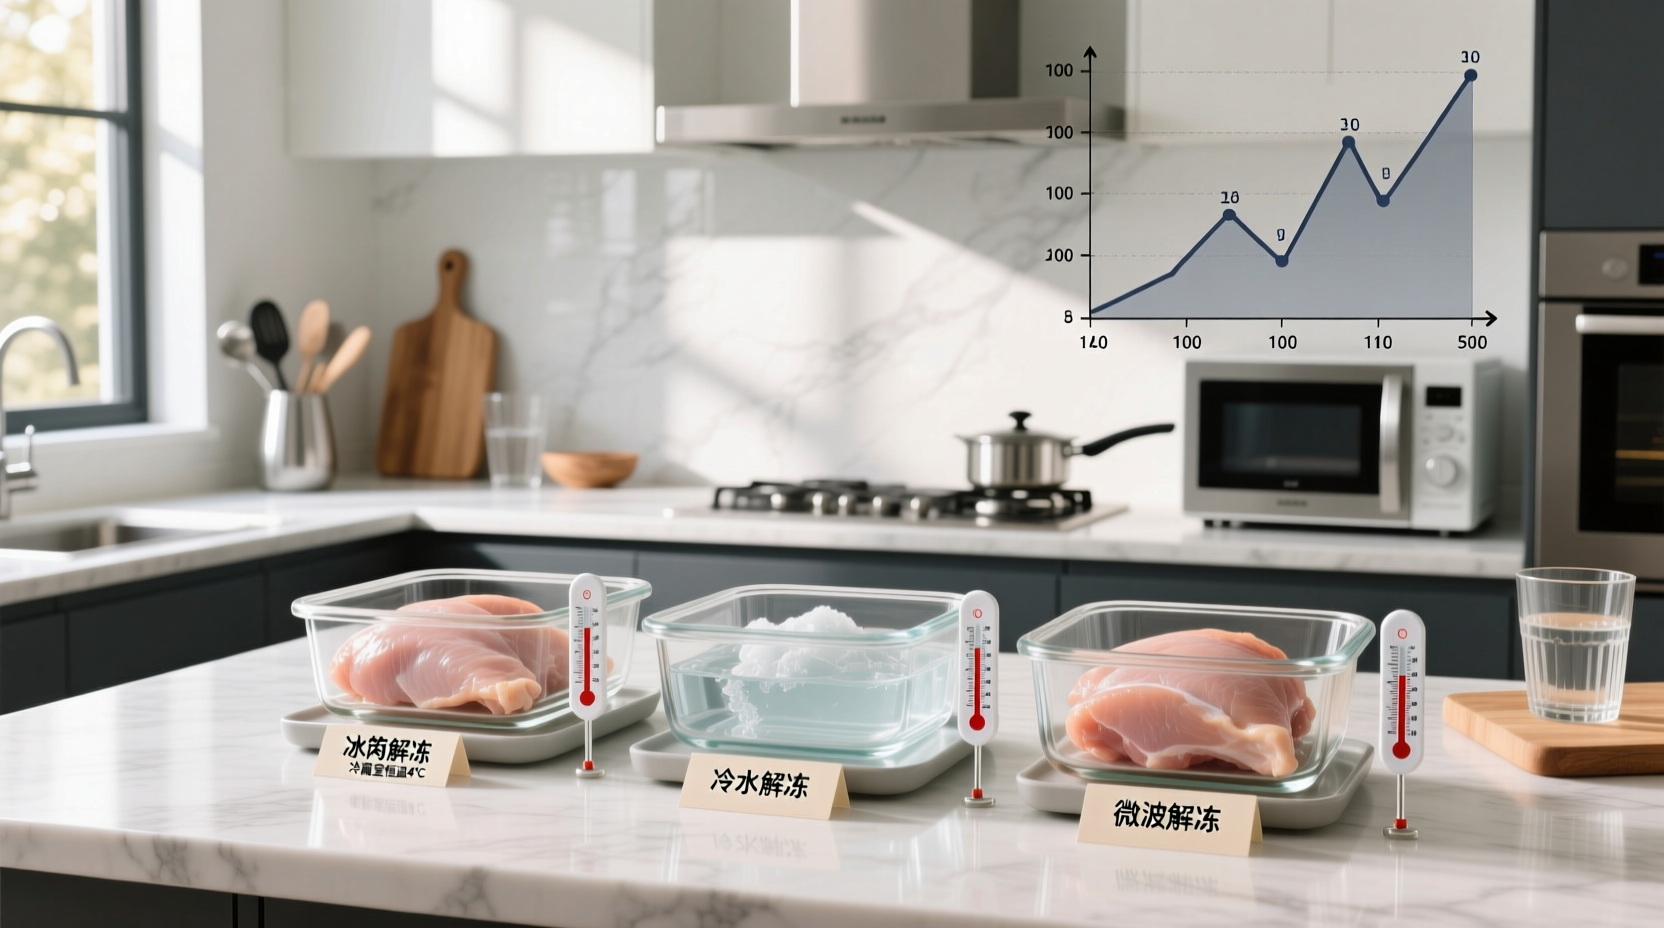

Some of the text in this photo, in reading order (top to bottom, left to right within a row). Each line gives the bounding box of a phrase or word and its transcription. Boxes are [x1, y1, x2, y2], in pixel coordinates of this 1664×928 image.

[710, 767, 810, 799] 冷水解冻
[1113, 798, 1221, 833] 微波解冻
